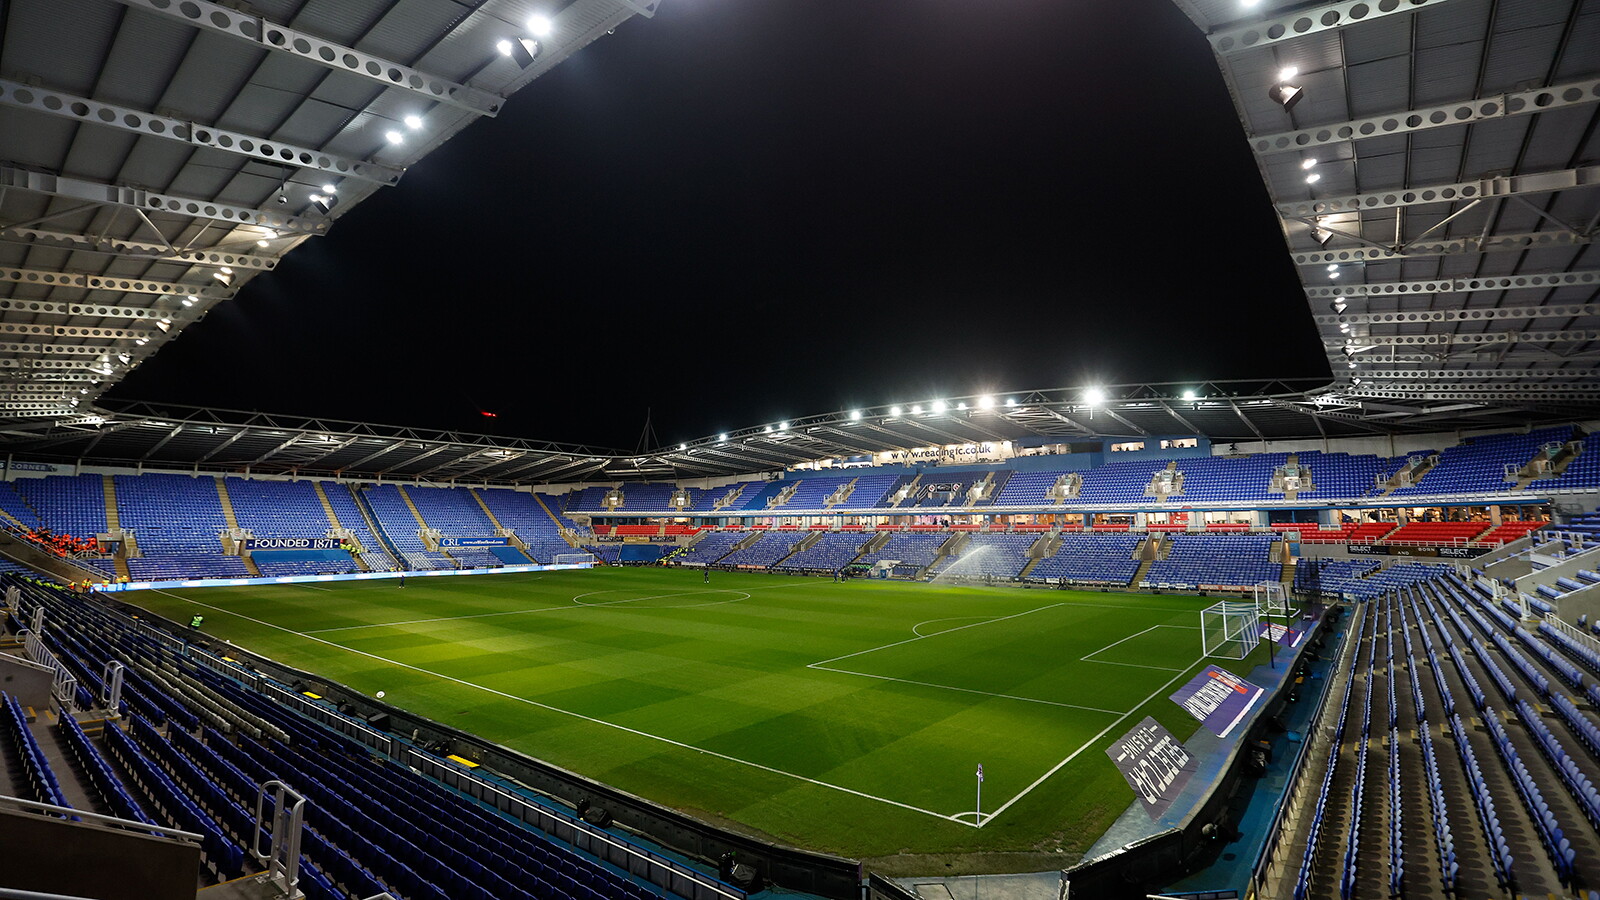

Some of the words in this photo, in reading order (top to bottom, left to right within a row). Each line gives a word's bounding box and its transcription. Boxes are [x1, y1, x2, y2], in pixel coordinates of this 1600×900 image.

[254, 539, 310, 548] FOUNDED
[313, 539, 333, 549] 1871
[1121, 726, 1157, 761] LEASING
[1146, 735, 1190, 786] SELECT
[1128, 758, 1167, 805] CAR
